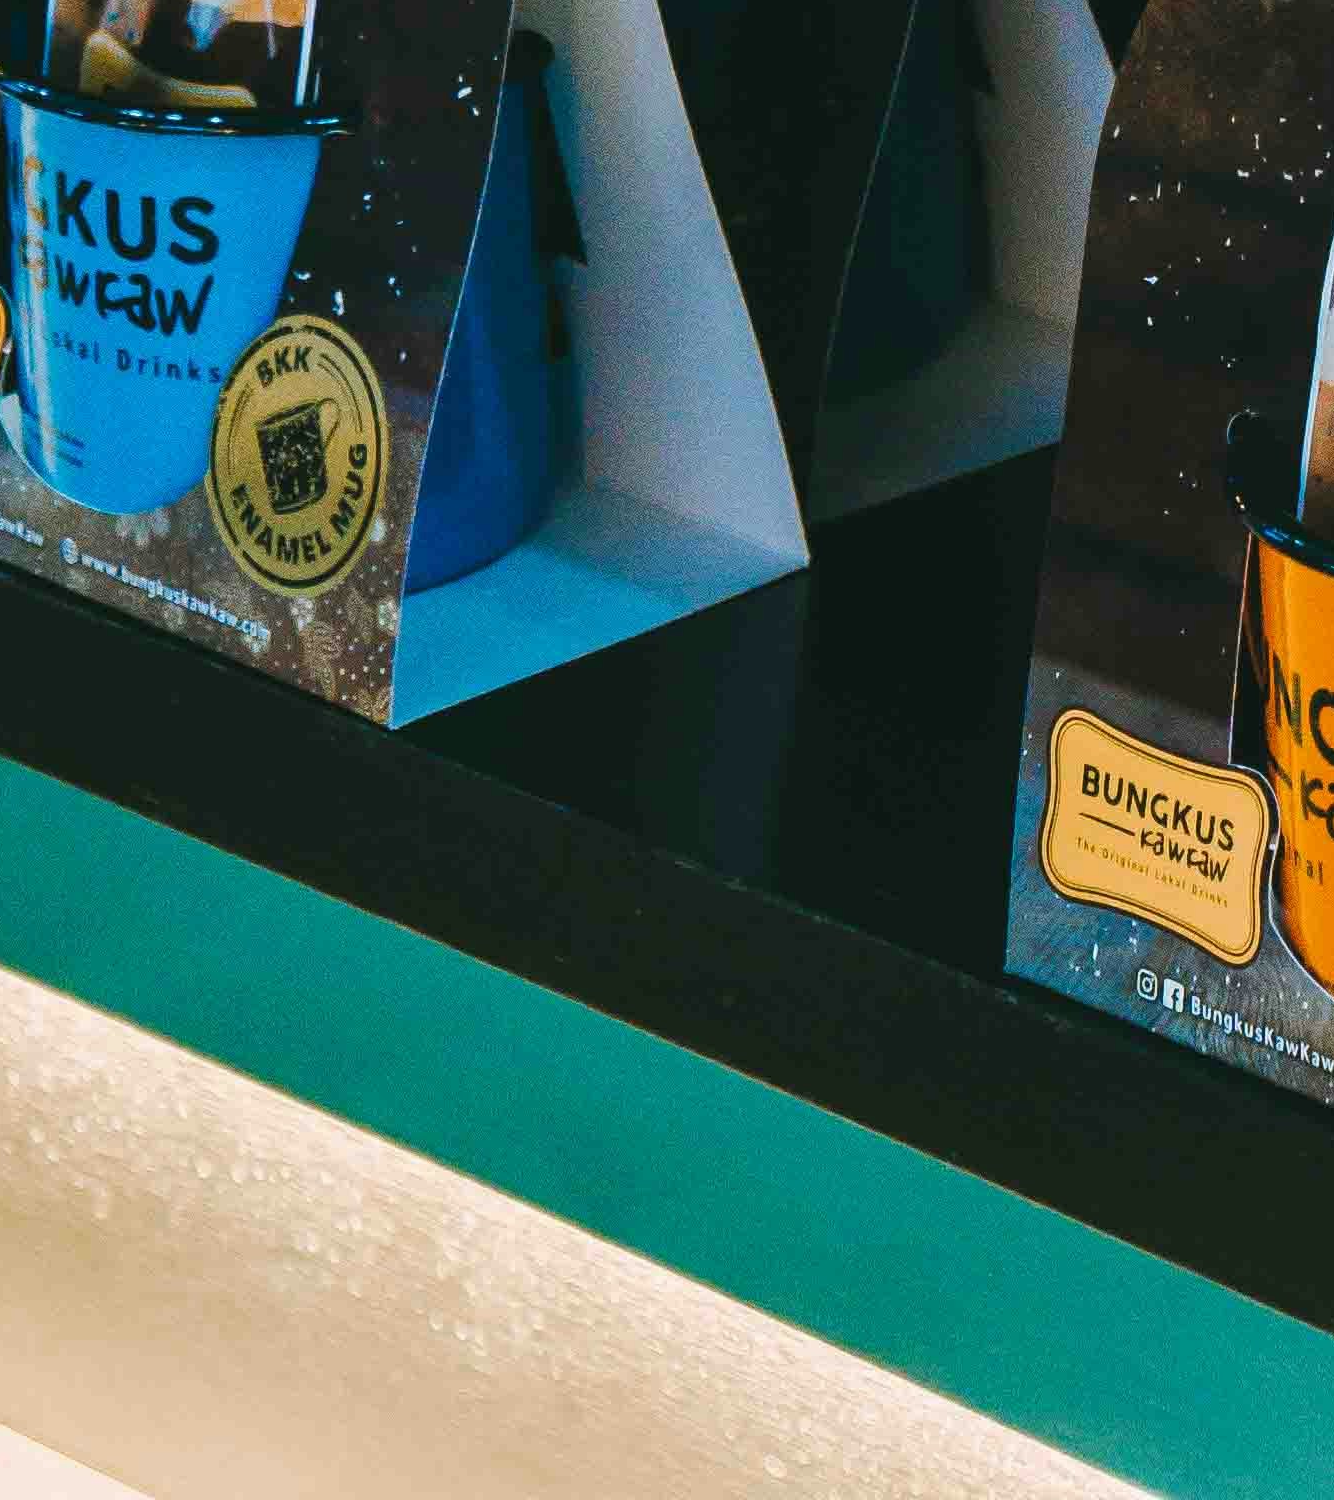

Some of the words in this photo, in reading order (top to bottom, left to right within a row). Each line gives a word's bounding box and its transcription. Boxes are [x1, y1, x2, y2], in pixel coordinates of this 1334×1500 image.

[117, 347, 223, 384] Drinks
[255, 345, 313, 389] BKK
[231, 482, 333, 566] ENAMEL
[329, 441, 369, 537] MUG
[1081, 763, 1235, 852] BUNGKUS
[1076, 836, 1095, 855] The
[1101, 844, 1150, 878] Original
[1154, 868, 1186, 890] Lokal
[1190, 880, 1229, 908] Drinks
